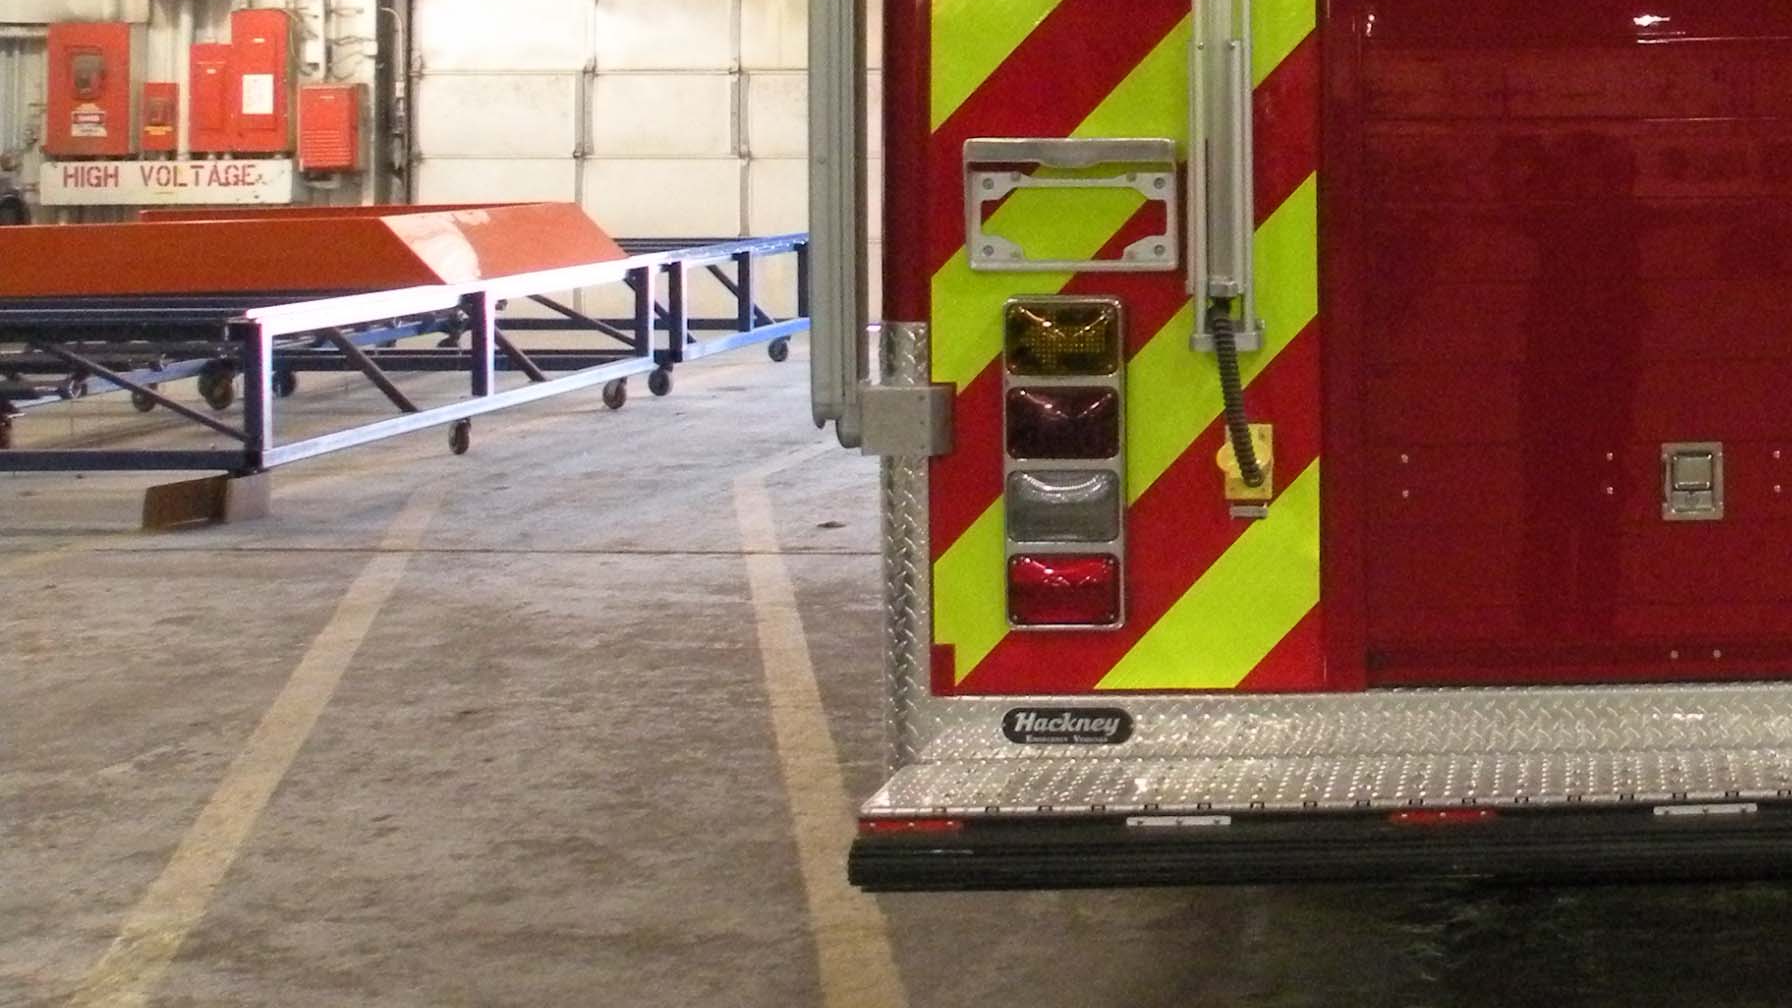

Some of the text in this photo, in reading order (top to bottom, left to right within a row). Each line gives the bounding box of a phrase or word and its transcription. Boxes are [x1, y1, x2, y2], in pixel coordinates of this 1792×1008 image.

[63, 164, 256, 188] HIGH VOLTAGE
[1014, 712, 1121, 736] Hackney
